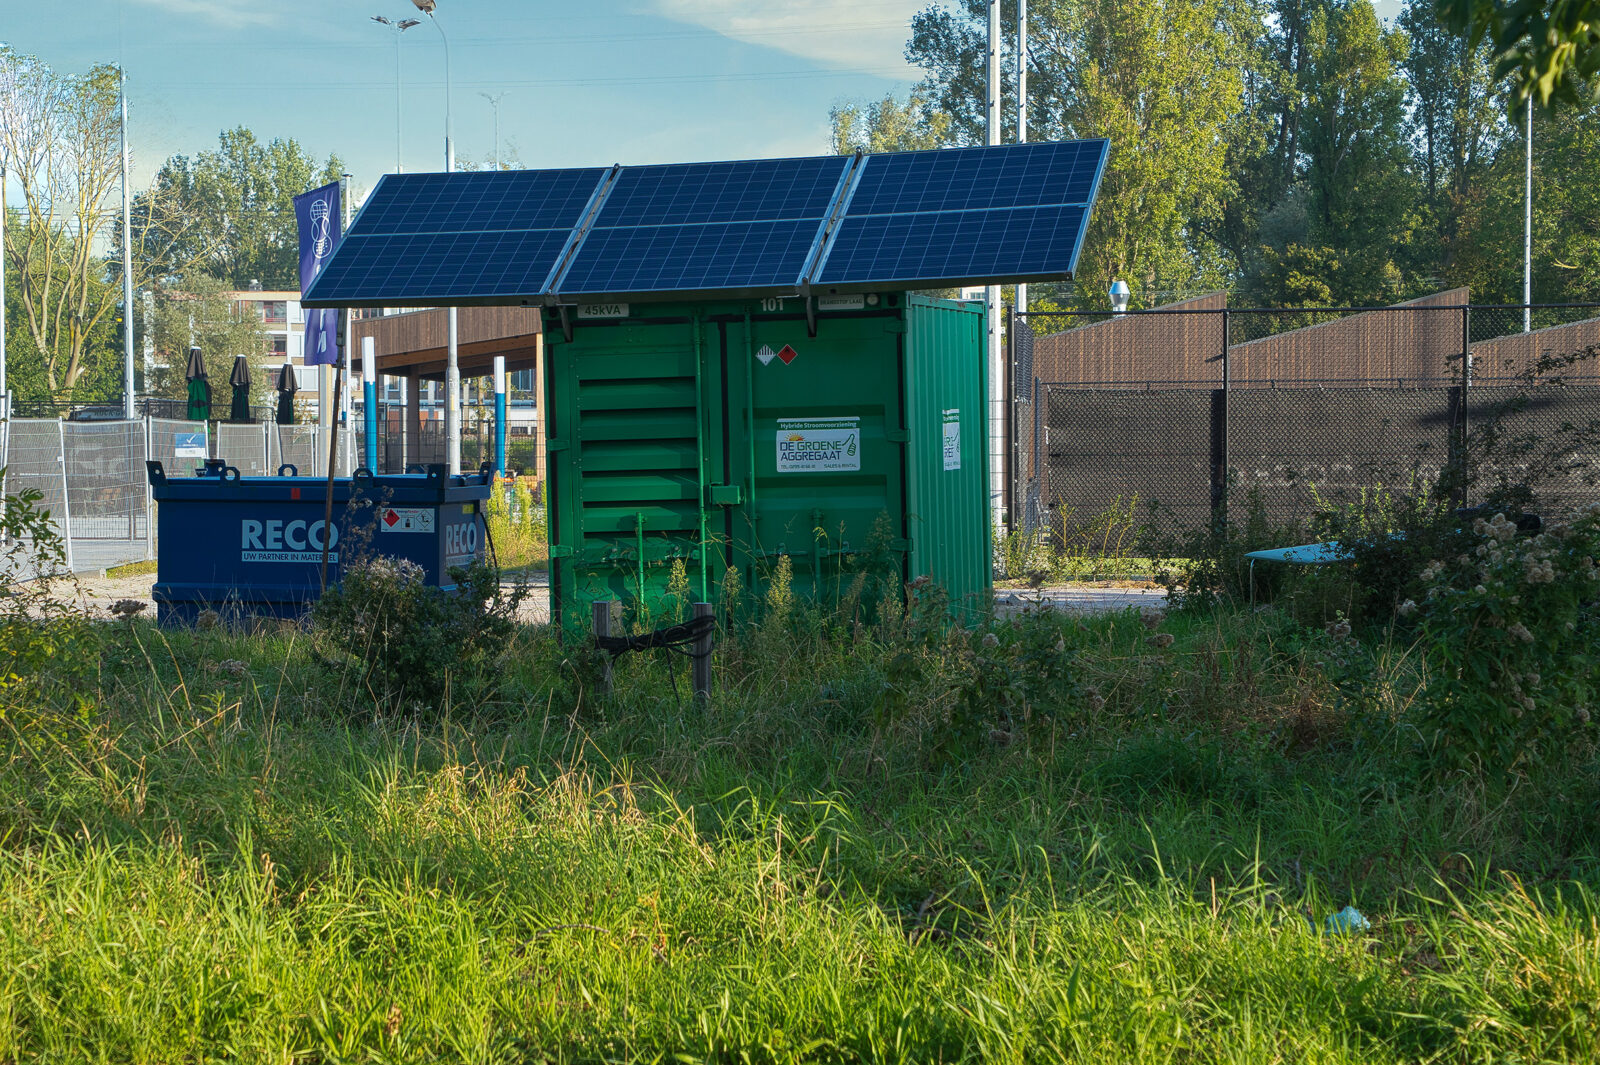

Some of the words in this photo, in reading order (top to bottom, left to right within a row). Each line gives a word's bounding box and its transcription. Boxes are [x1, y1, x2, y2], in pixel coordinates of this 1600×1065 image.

[584, 305, 621, 315] 45kVA
[760, 298, 784, 312] 101
[780, 441, 795, 451] DE
[797, 440, 842, 451] GROENE
[780, 451, 842, 461] AGGREGAAT
[242, 519, 339, 551] RECO
[445, 522, 477, 554] RECO
[243, 552, 258, 561] UW
[259, 553, 289, 561] PARTNER
[290, 553, 299, 561] IN
